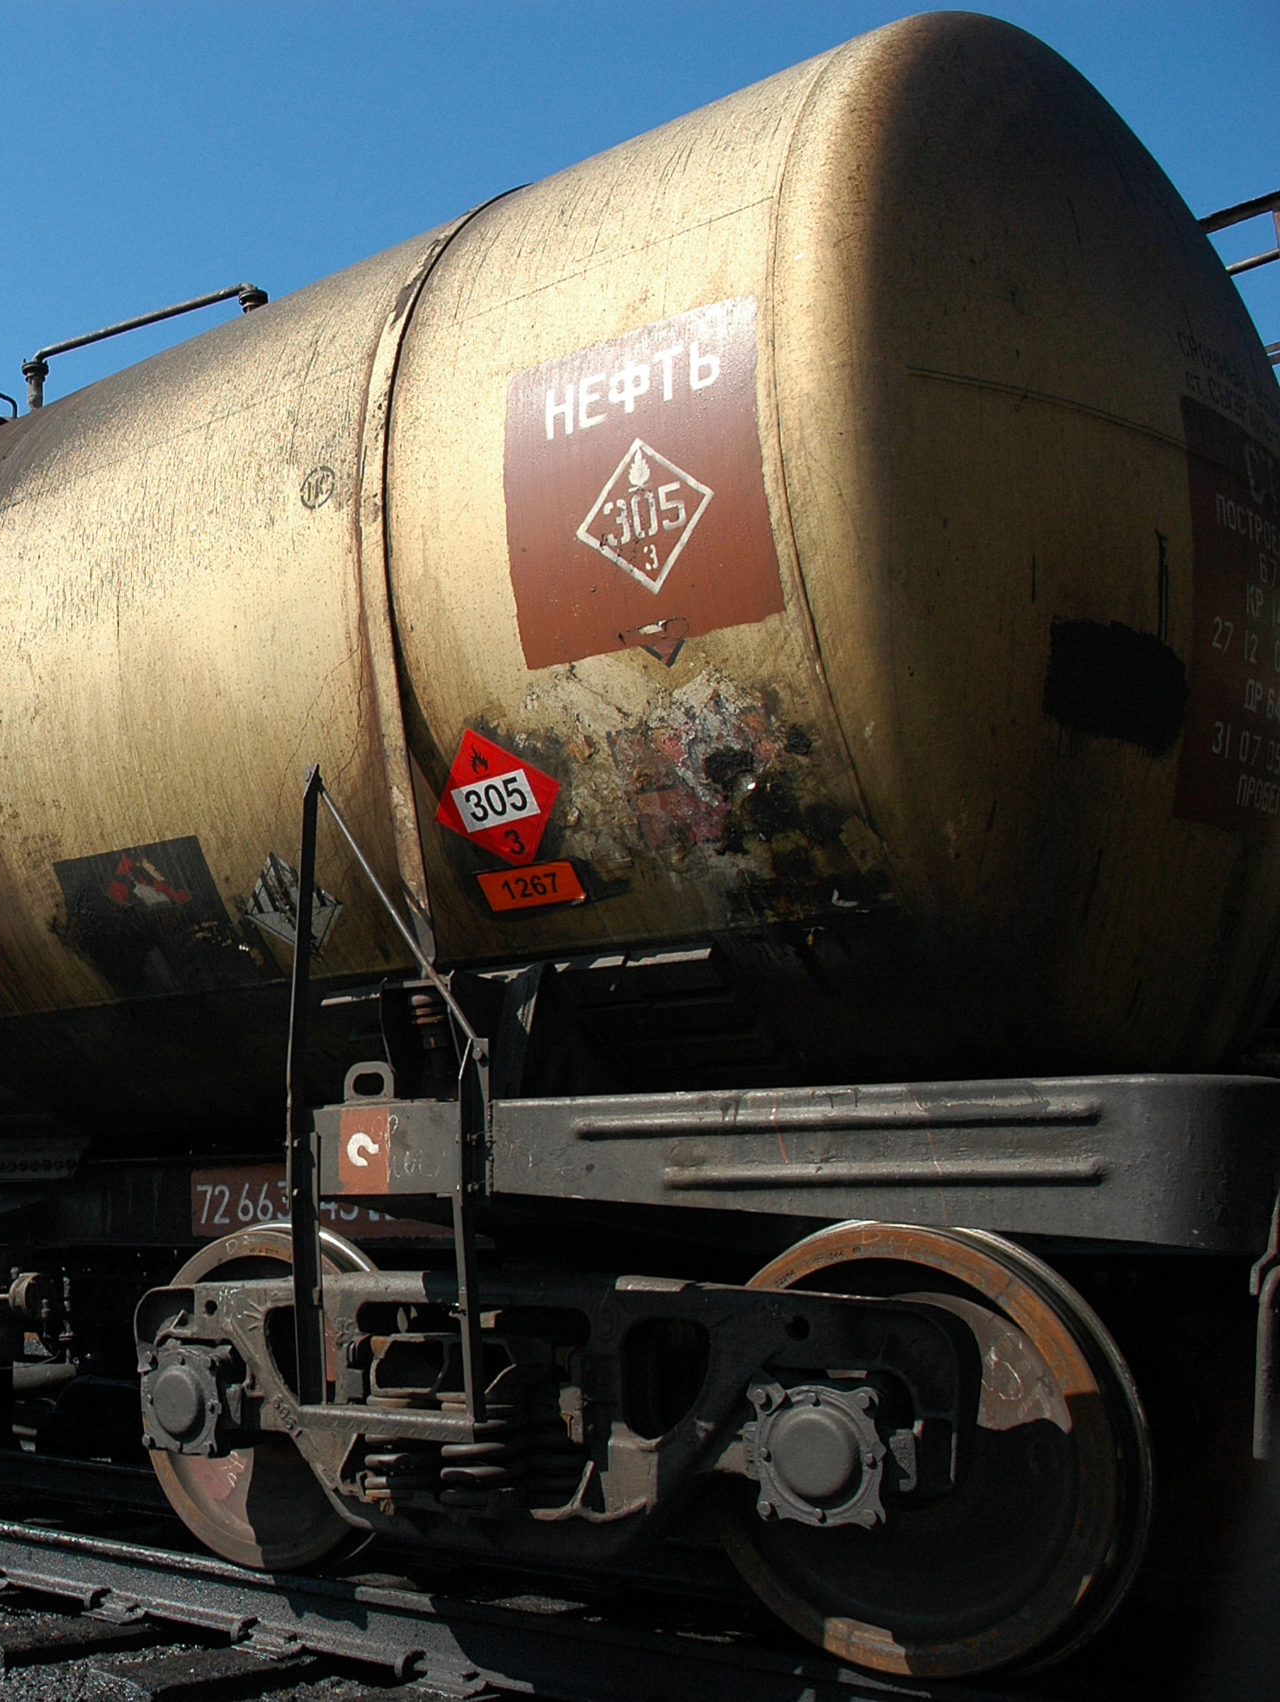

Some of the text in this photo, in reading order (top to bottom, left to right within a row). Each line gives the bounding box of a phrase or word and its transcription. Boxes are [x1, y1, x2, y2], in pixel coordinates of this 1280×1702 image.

[544, 342, 721, 440] НЕФТЬ
[602, 480, 687, 547] 305
[643, 544, 659, 570] 3
[1211, 616, 1234, 653] 27
[1211, 720, 1232, 760] 31
[464, 776, 528, 823] 305
[504, 829, 526, 855] 3
[501, 872, 559, 900] 1267
